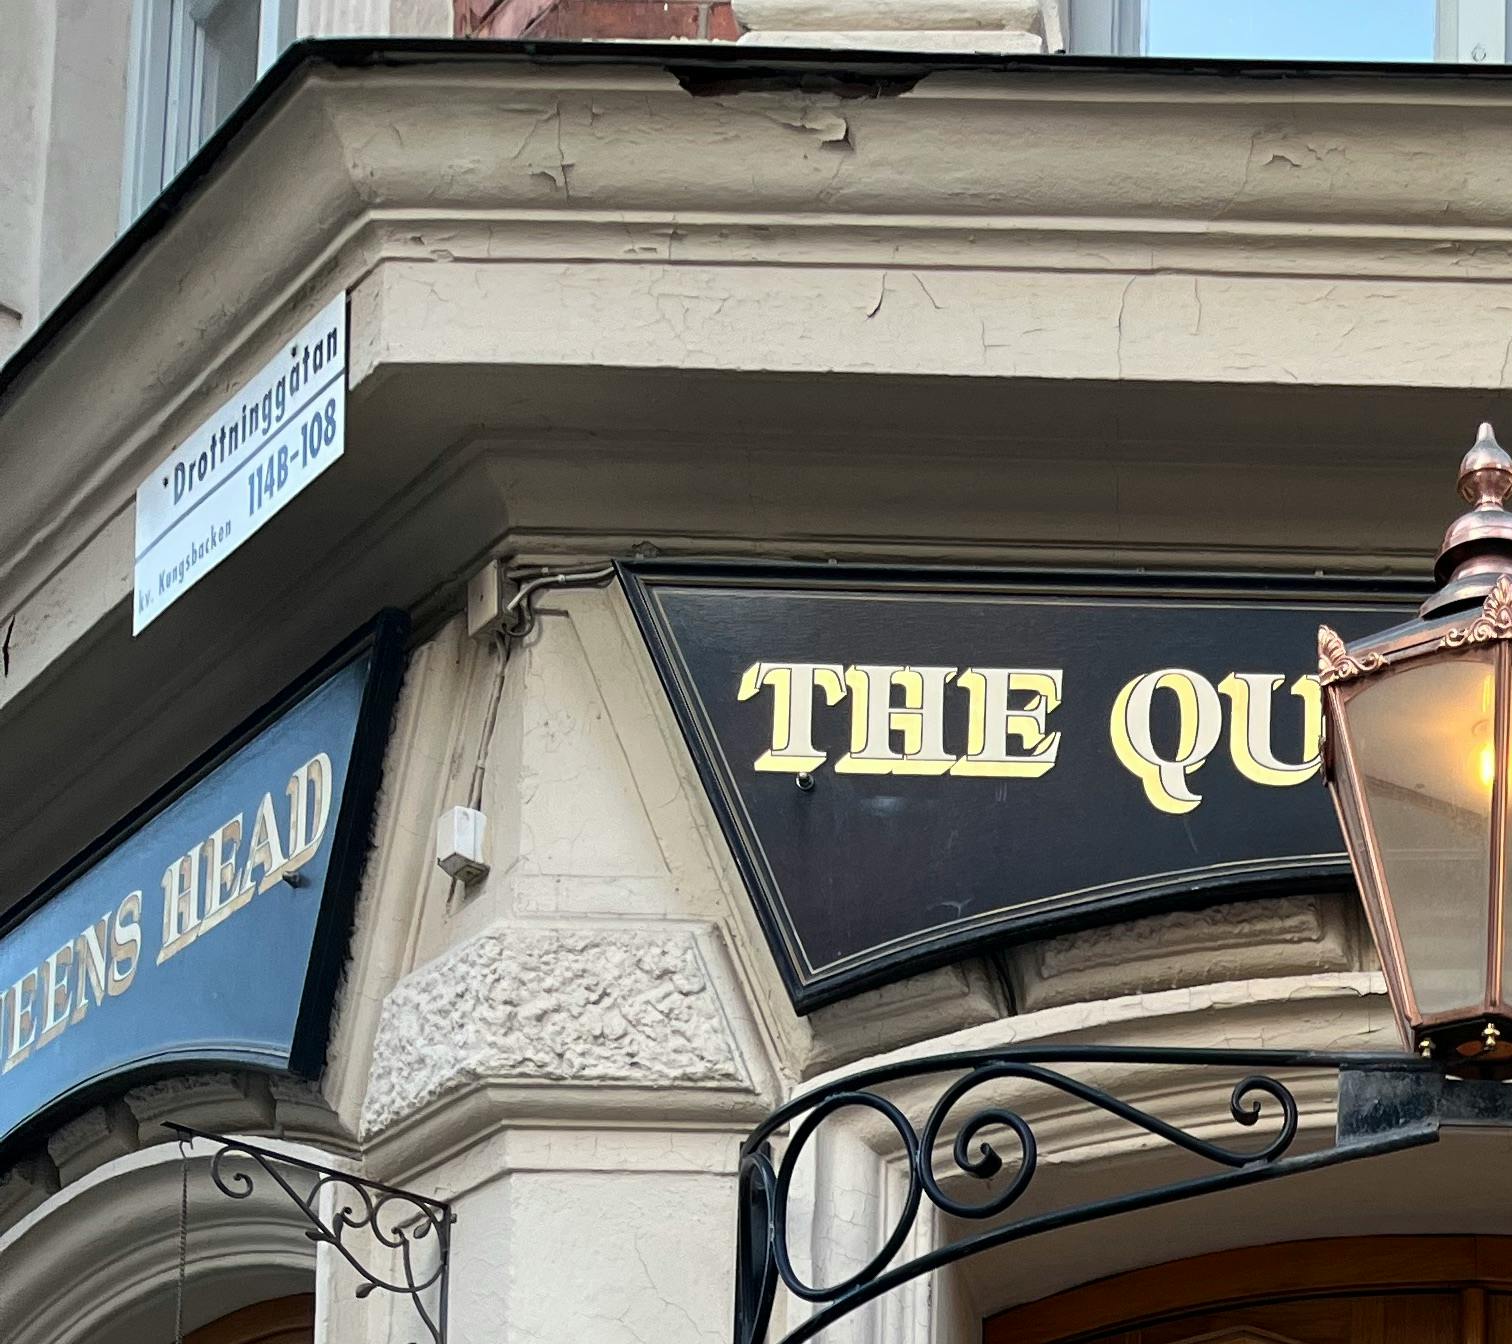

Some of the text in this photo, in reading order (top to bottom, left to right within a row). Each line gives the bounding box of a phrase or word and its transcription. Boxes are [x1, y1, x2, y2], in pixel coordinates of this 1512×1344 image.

[247, 398, 337, 518] 114B-108
[157, 519, 232, 593] Kungsbacken
[737, 662, 1064, 776] THE
[0, 752, 333, 1076] EENS HEAD
